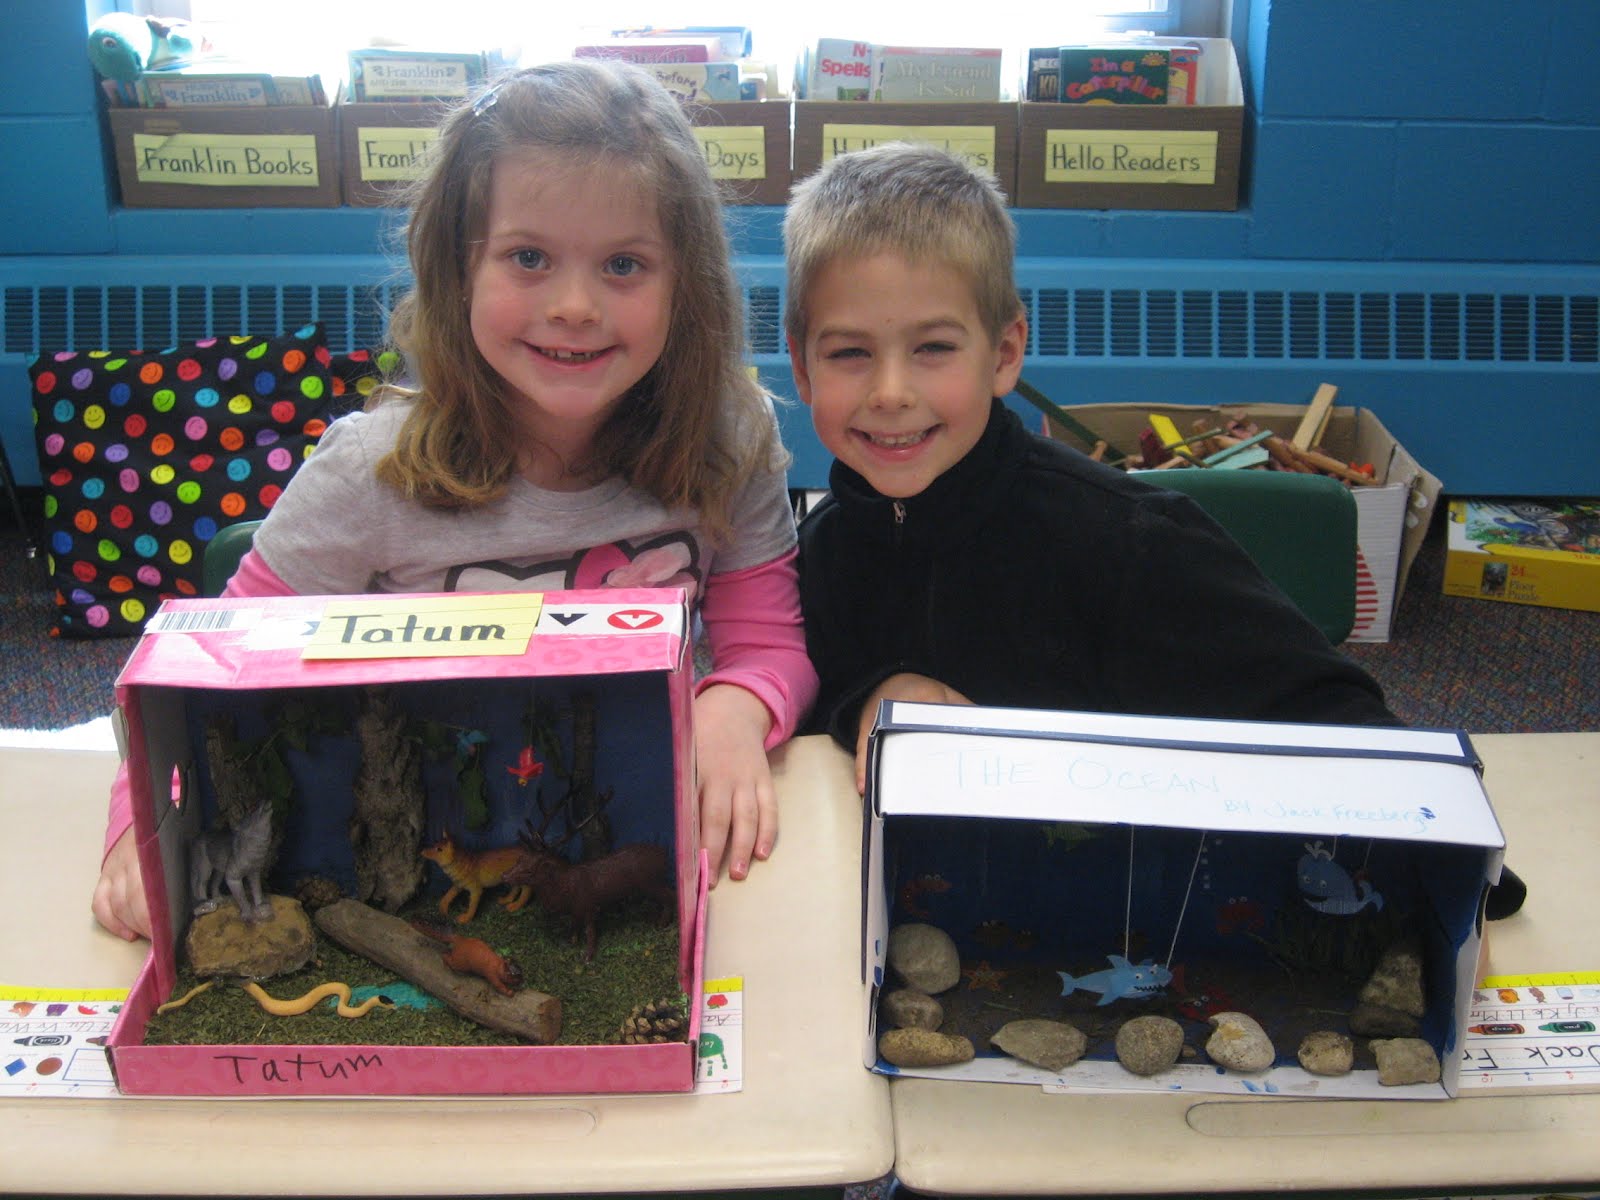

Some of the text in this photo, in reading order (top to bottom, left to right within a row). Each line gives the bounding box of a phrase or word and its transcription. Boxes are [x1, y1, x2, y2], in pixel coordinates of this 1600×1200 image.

[386, 65, 445, 78] Franklin
[656, 71, 696, 87] Before
[822, 58, 871, 77] Spells
[897, 62, 991, 79] My Friend
[1121, 61, 1136, 73] a
[143, 147, 313, 175] Franklin Books
[704, 141, 758, 174] Days
[1053, 144, 1200, 171] Hello Readers
[328, 614, 505, 644] Tatum
[930, 748, 1220, 793] THE OCEAN
[214, 1053, 382, 1083] Tatum
[1524, 1044, 1600, 1067] Jack
